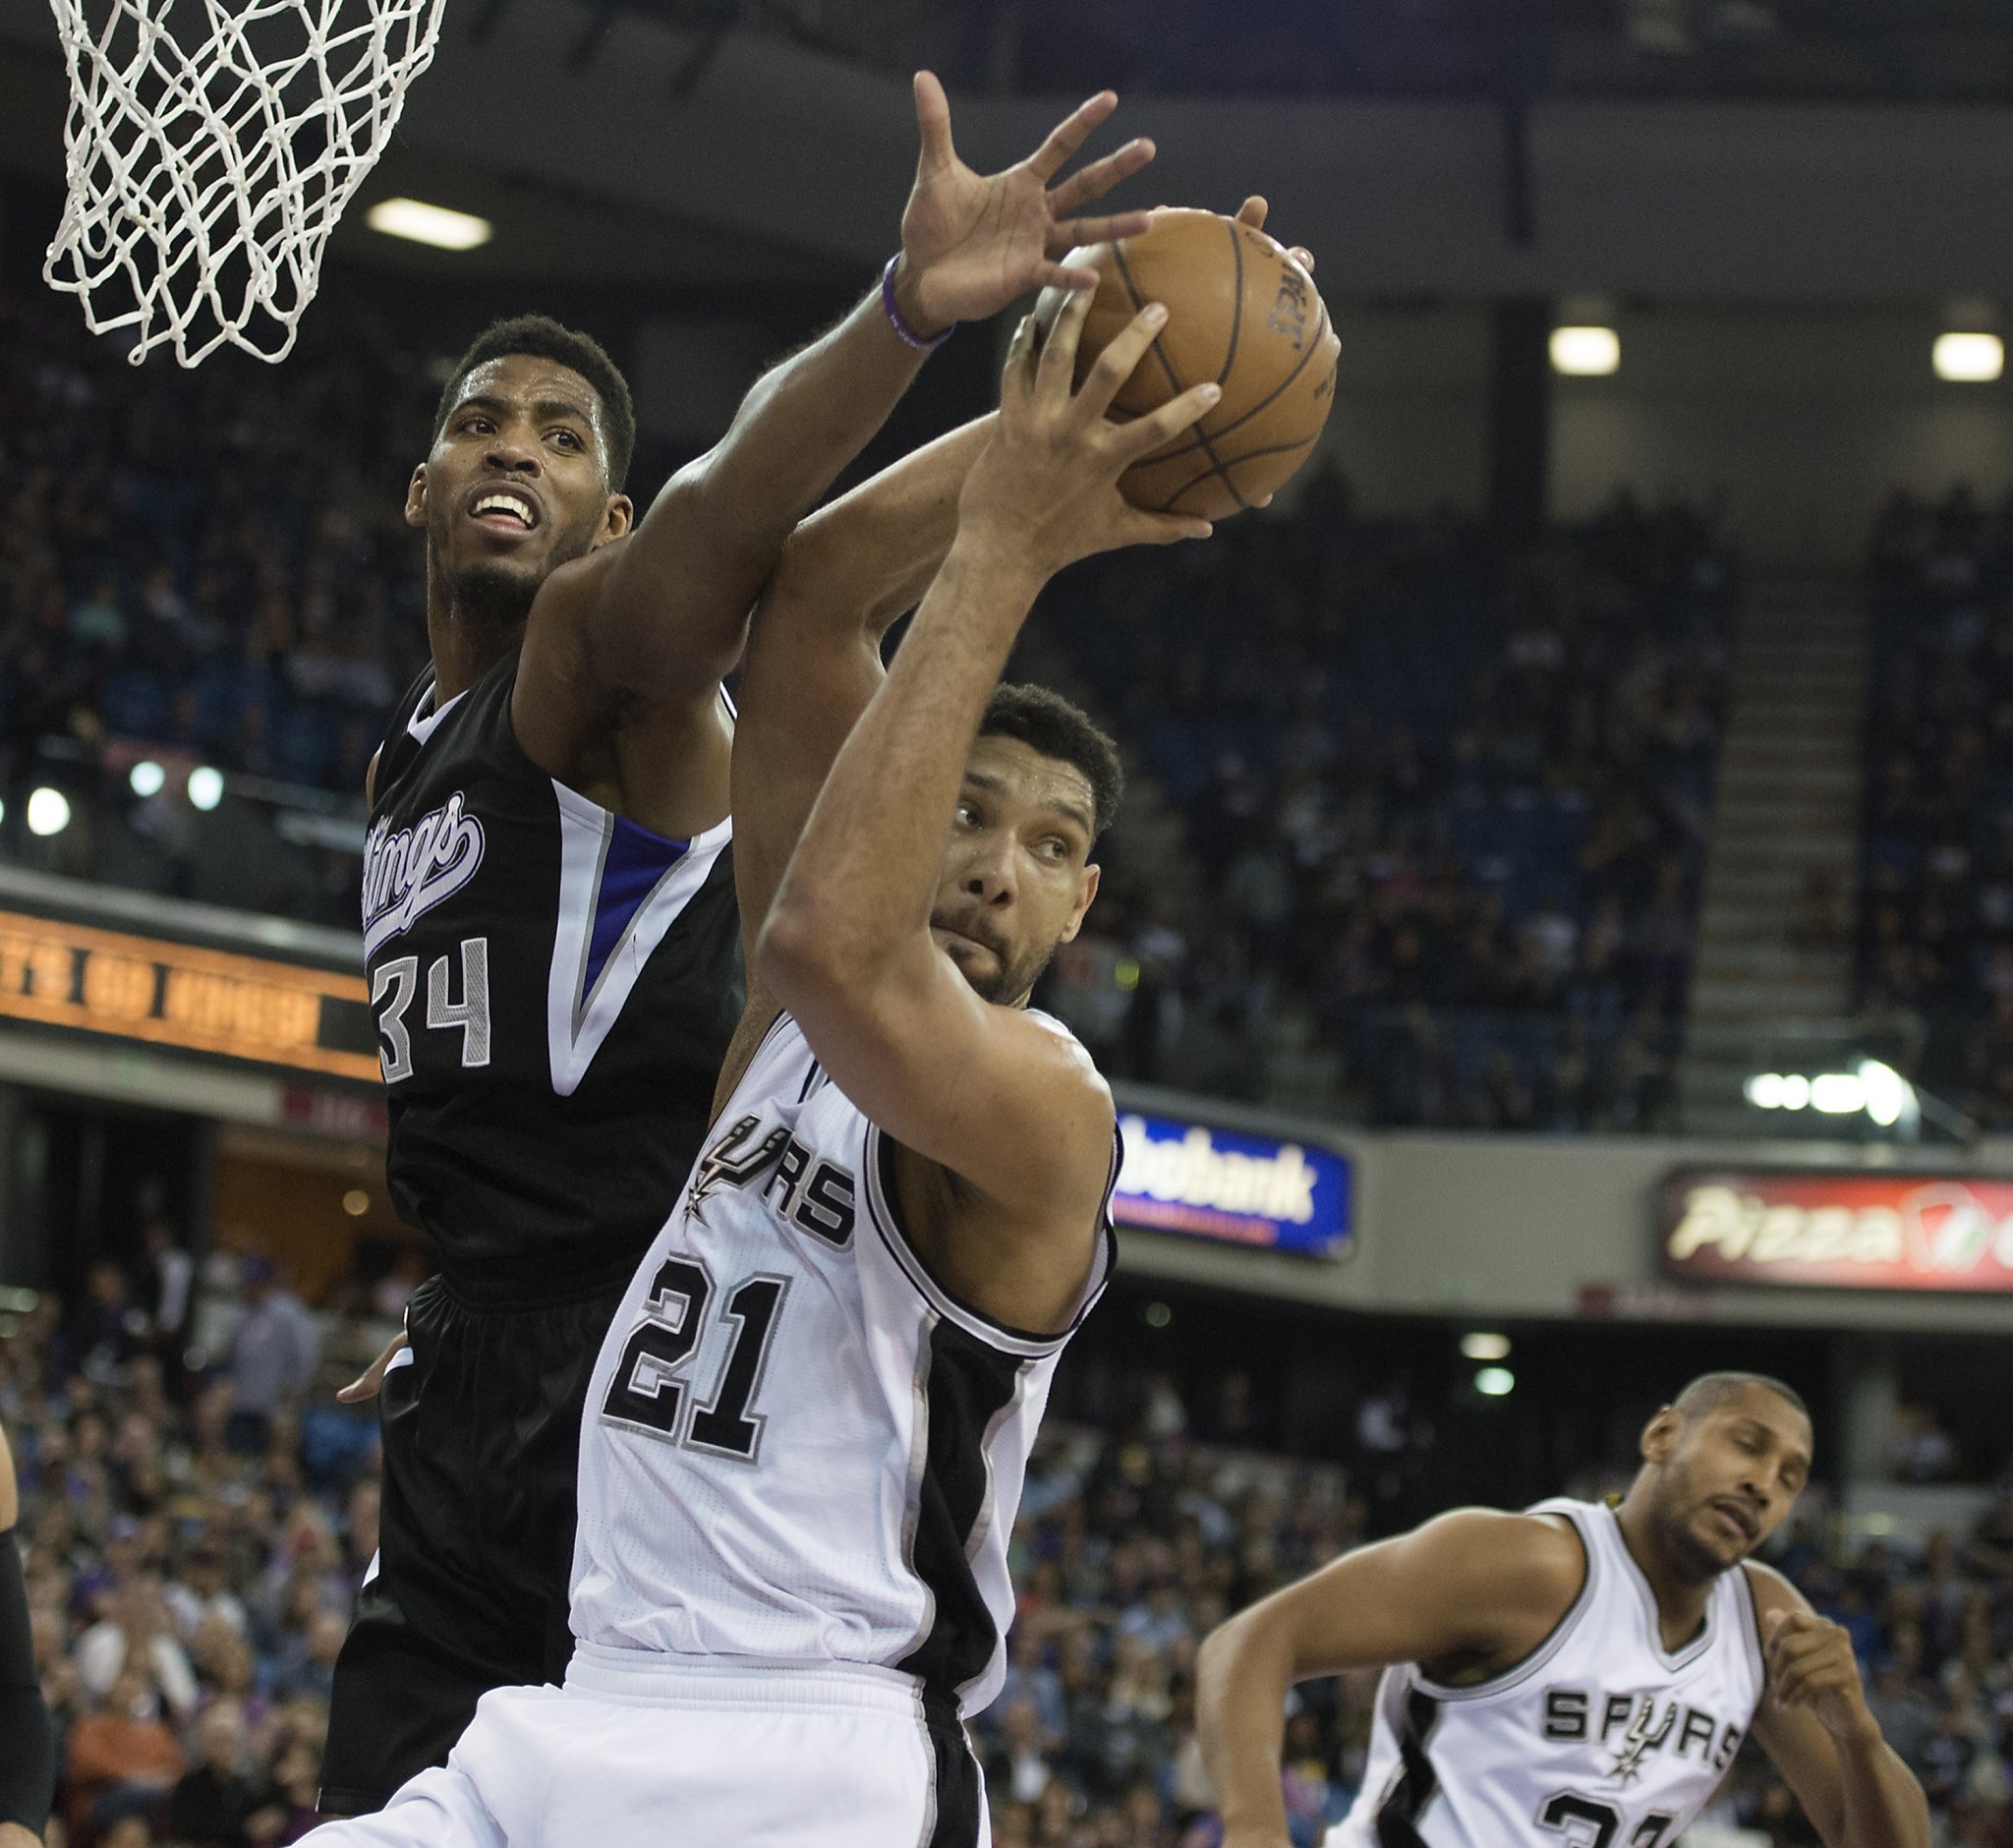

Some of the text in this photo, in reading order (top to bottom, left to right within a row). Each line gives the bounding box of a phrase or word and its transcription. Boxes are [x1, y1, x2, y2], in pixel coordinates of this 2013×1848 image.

[362, 790, 485, 971] ings
[372, 938, 491, 1084] 34
[683, 1112, 856, 1254] URS
[1117, 1114, 1318, 1225] bobank
[1668, 1184, 1903, 1262] Pizza
[599, 1249, 793, 1466] 21
[1541, 1688, 1743, 1784] SPURS
